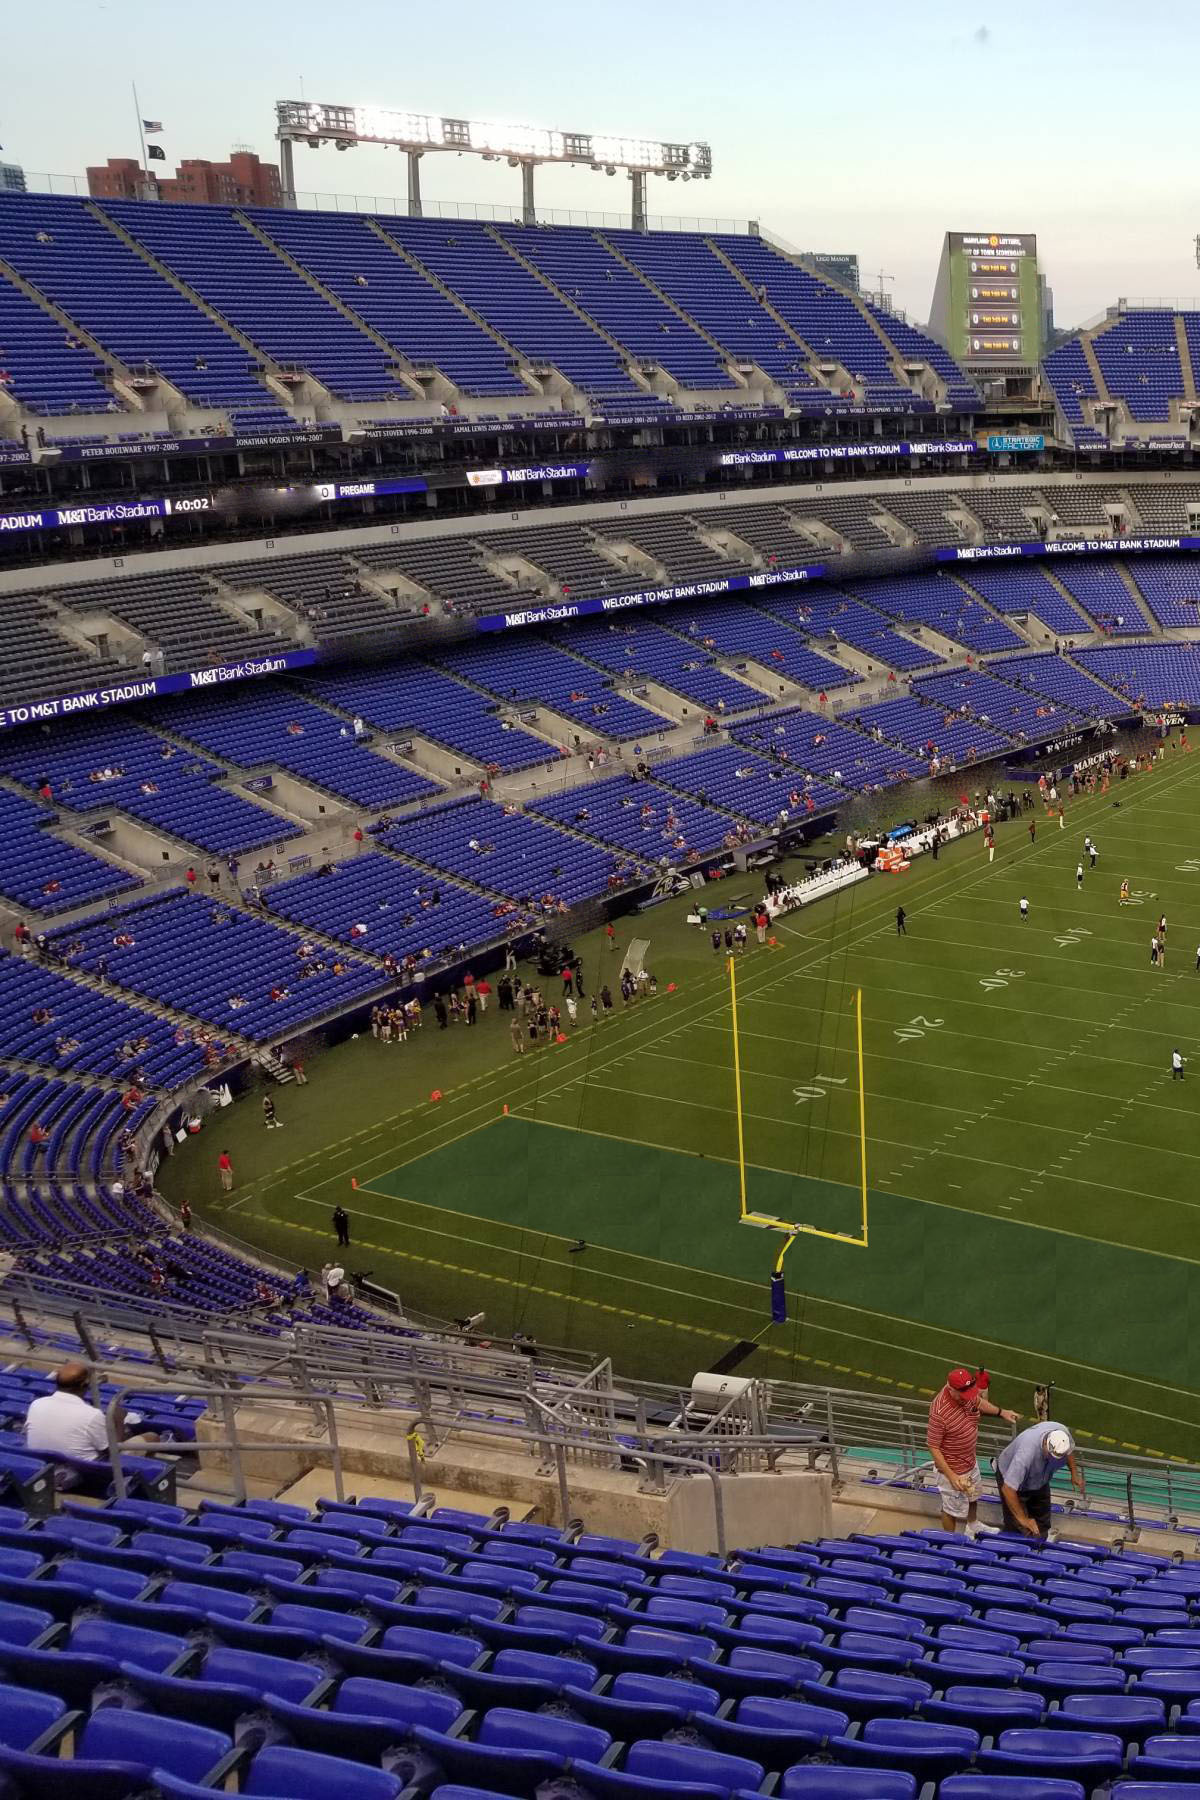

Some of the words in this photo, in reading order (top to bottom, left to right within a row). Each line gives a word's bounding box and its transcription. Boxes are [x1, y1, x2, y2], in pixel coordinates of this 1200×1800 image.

[366, 430, 382, 438] MATT
[382, 429, 404, 438] STOVER
[236, 438, 268, 447] JONATHAN
[269, 436, 291, 445] OGDEN
[910, 443, 928, 453] M&T
[928, 443, 945, 453] Bank
[945, 442, 973, 452] Stadium
[82, 447, 104, 457] PETER
[105, 445, 142, 455] BOULWARE
[143, 443, 179, 452] 1997-2005
[784, 450, 817, 460] WELCOME
[819, 448, 828, 457] TO
[831, 447, 846, 457] M&T
[848, 446, 868, 456] BANK
[869, 445, 900, 455] STADIUM
[734, 453, 751, 464] Bank
[751, 452, 776, 462] Stadium
[507, 469, 527, 482] M&T
[527, 468, 546, 480] Bank
[546, 467, 577, 479] Stadium
[340, 484, 375, 496] PREGAME
[175, 498, 209, 512] 40:02
[58, 508, 88, 525] M&T
[88, 506, 115, 522] Bank
[115, 503, 160, 519] Stadium
[957, 548, 975, 559] M&T
[975, 547, 993, 558] Bank
[993, 545, 1021, 556] Stadium
[1045, 542, 1085, 552] WELCOME
[1087, 541, 1099, 551] TO
[1100, 541, 1118, 550] M&T
[1119, 540, 1142, 550] BANK
[1143, 539, 1180, 549] STADIUM
[750, 574, 767, 586] M&T
[767, 572, 782, 584] Bank
[782, 568, 807, 582] Stadium
[602, 593, 643, 610] WELCOME
[645, 591, 655, 602] TO
[657, 588, 674, 601] M&T
[675, 585, 697, 598] BANK
[698, 580, 729, 594] STADIUM
[505, 612, 527, 627] M&T
[527, 609, 547, 623] Bank
[547, 605, 578, 620] Stadium
[191, 671, 218, 687] M&T
[218, 664, 244, 681] Bank
[244, 658, 286, 676] Stadium
[8, 707, 29, 723] TO
[31, 700, 59, 719] M&T
[63, 692, 98, 712] BANK
[101, 681, 156, 704] STADIUM
[978, 968, 1026, 988] 30
[893, 1015, 945, 1038] 20
[792, 1073, 848, 1098] 10
[720, 1382, 728, 1392] 6
